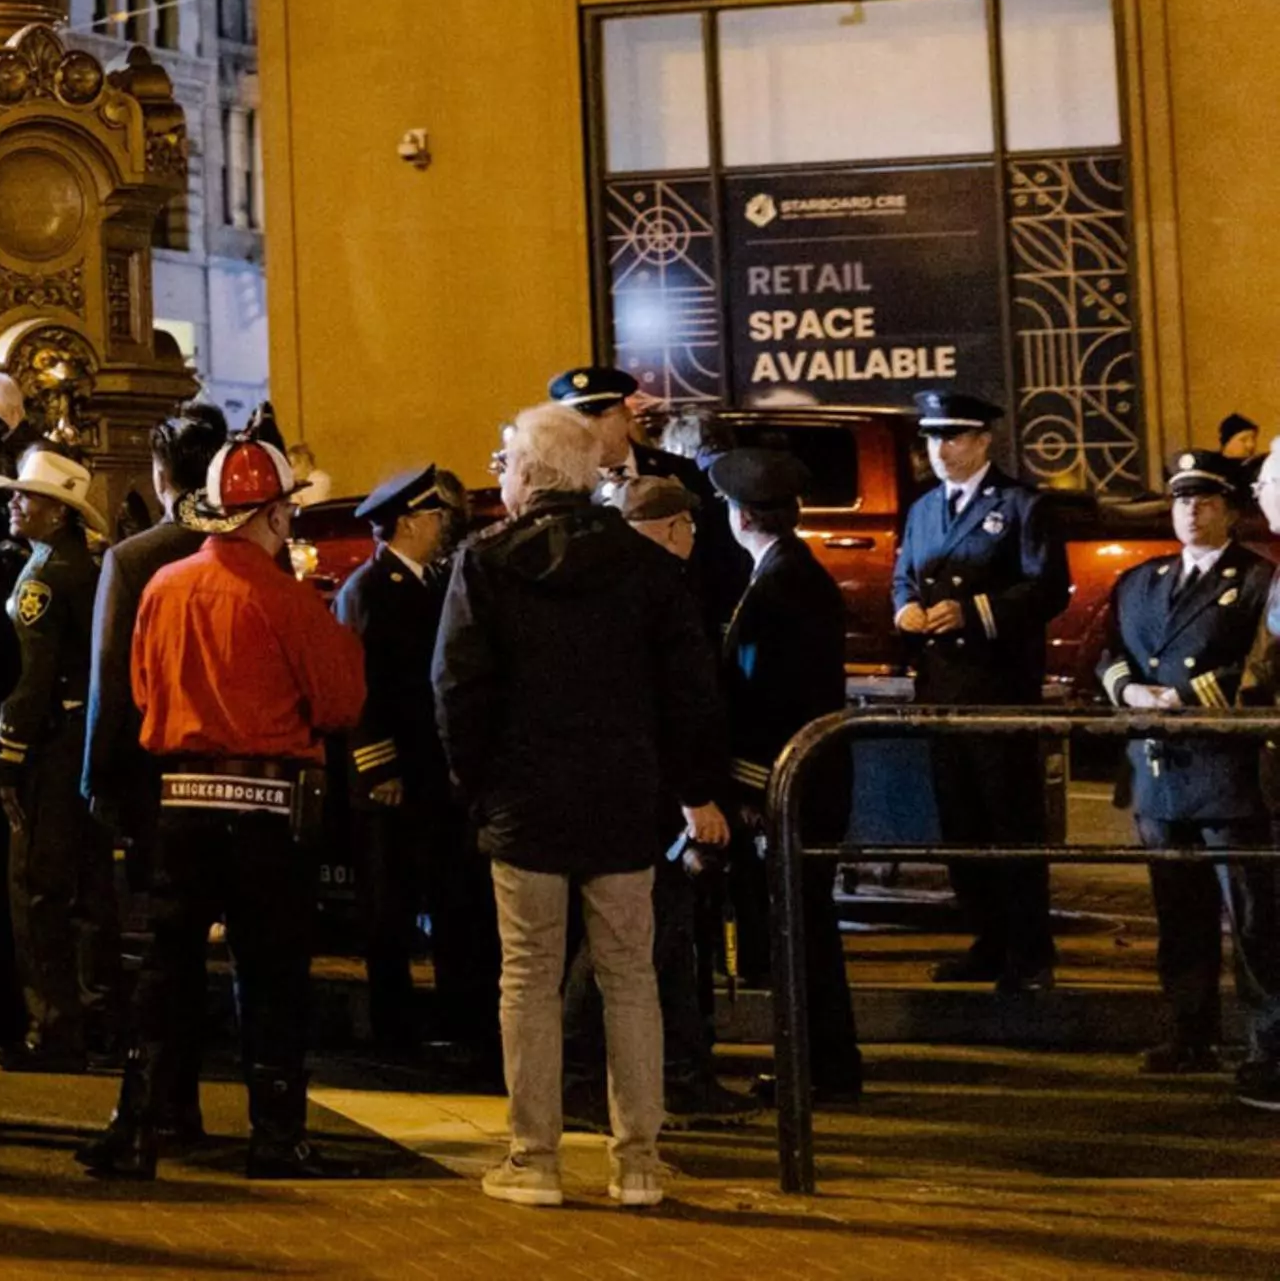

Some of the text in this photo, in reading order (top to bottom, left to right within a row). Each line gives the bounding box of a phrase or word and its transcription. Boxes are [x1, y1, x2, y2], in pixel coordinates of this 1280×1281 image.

[747, 262, 871, 296] RETAIL
[749, 307, 875, 341] SPACE
[751, 345, 957, 383] AVAILABLE
